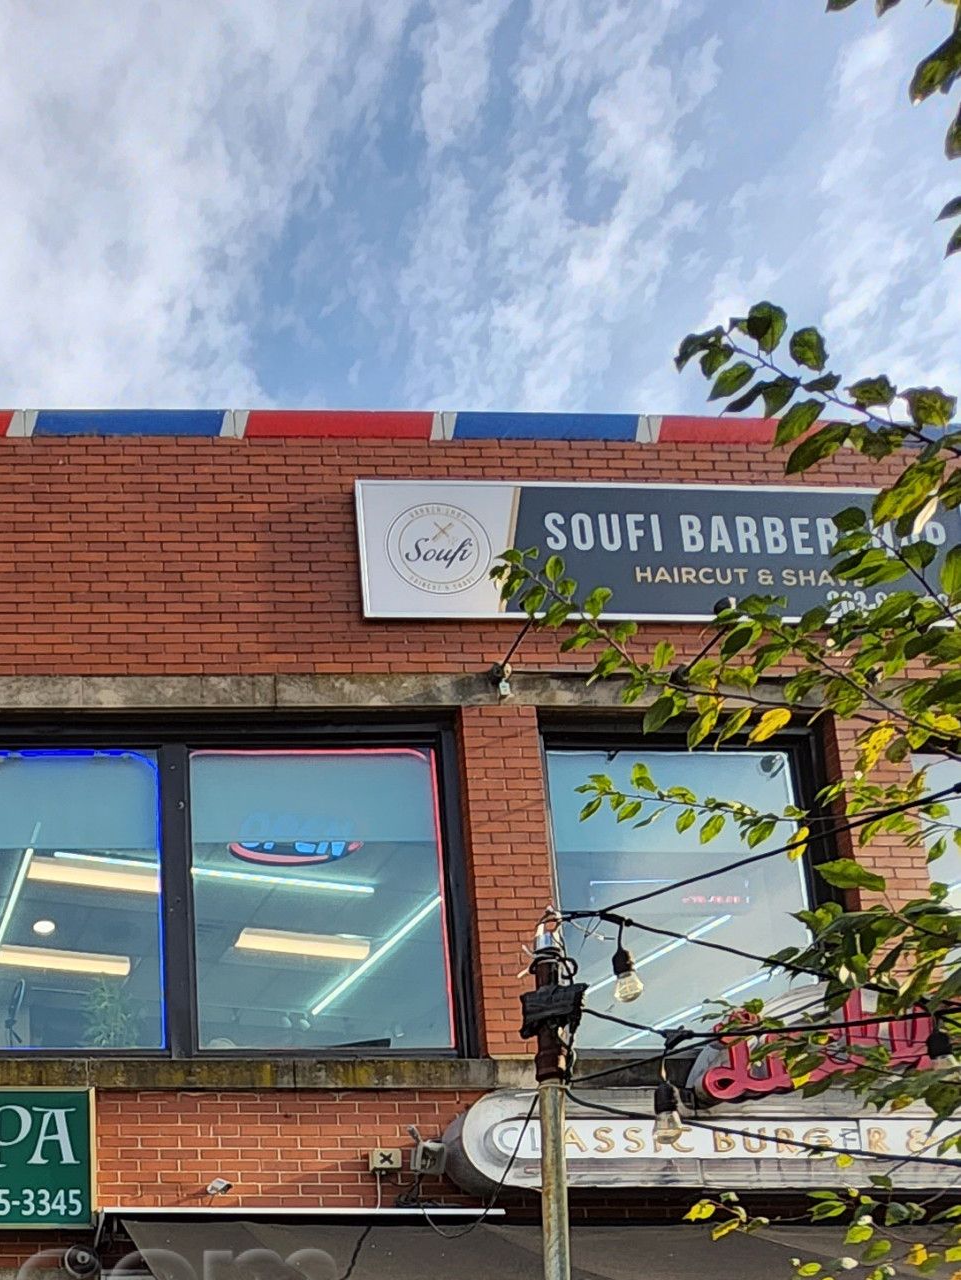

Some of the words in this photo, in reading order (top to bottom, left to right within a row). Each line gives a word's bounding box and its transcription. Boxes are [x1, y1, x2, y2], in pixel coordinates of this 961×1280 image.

[544, 512, 663, 552] SOUFI
[404, 537, 474, 569] Soufi
[636, 566, 749, 585] HAIRCUT
[758, 568, 774, 586] &
[782, 568, 865, 588] SHA
[905, 1127, 937, 1153] &
